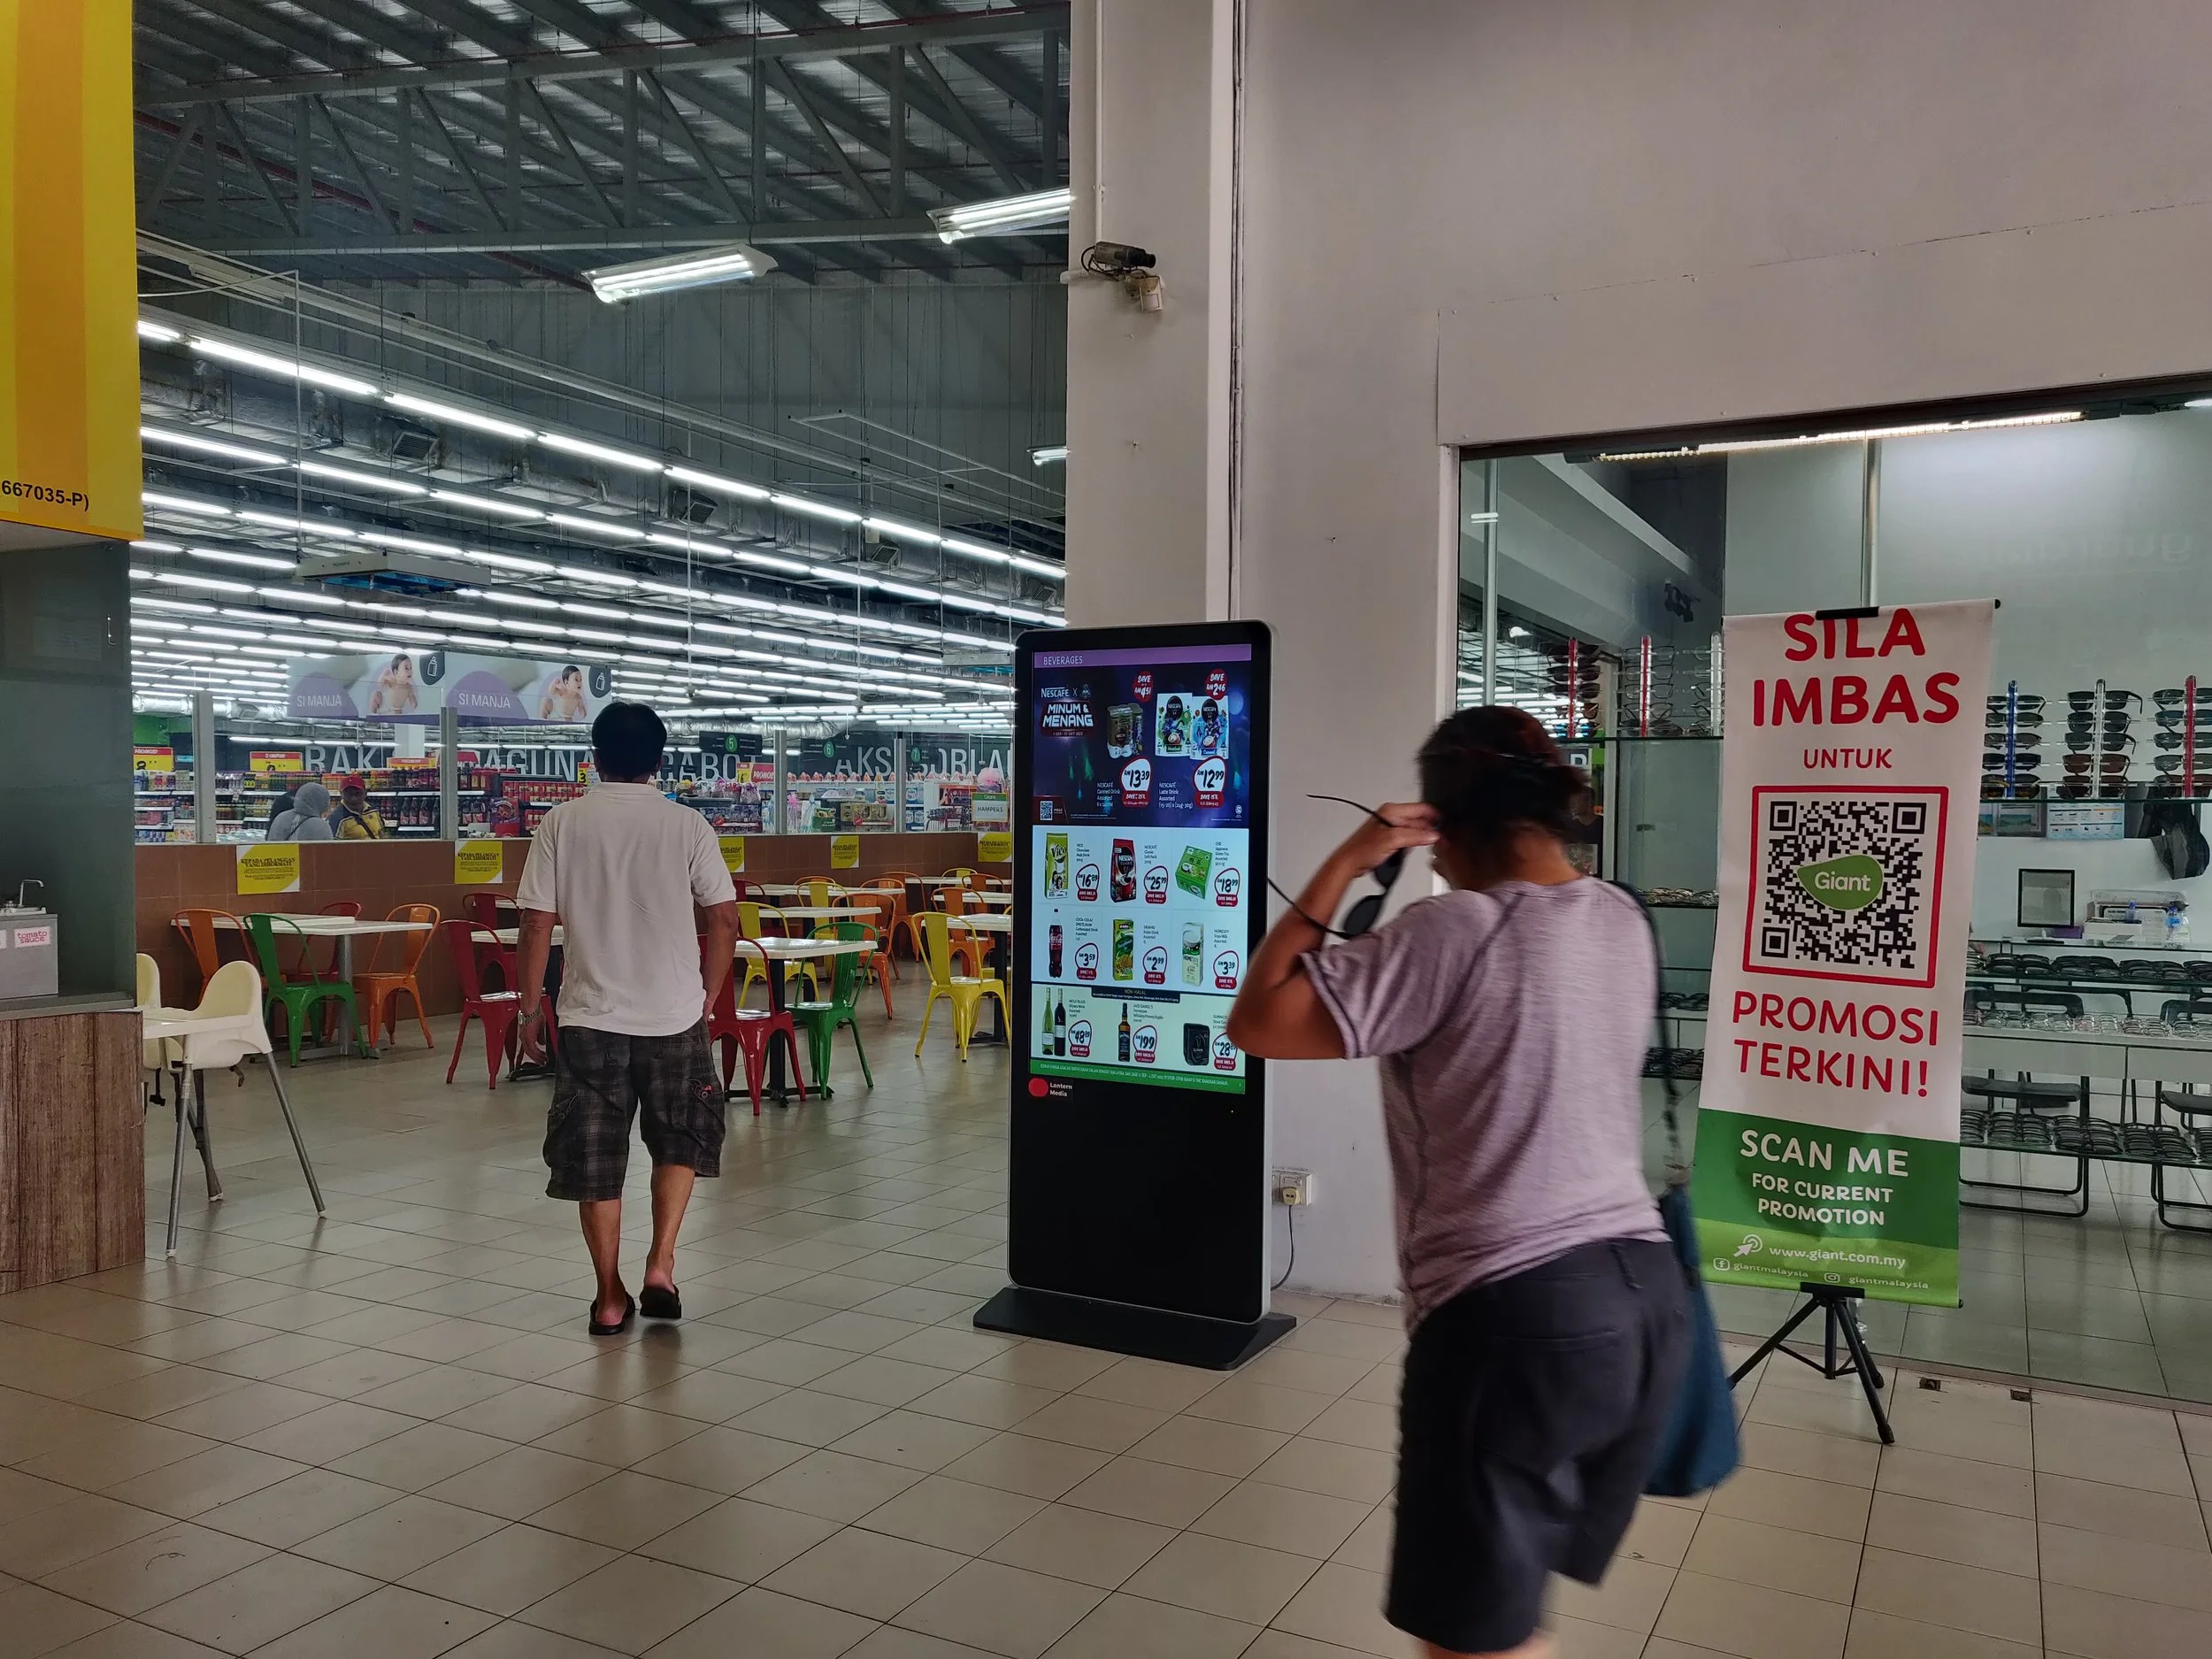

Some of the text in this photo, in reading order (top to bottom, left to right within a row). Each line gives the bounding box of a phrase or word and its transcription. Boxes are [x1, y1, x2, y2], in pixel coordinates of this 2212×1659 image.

[1783, 608, 1926, 662] SILA
[1043, 656, 1083, 665] BEVERAGES
[296, 695, 342, 707] SI MANJA
[458, 693, 511, 709] SI MANJA
[1048, 703, 1090, 714] MINUM &
[1753, 672, 1961, 726] IMBAS
[1042, 714, 1094, 727] MENANG
[728, 737, 733, 749] 5
[826, 744, 831, 755] 6
[1803, 748, 1893, 769] UNTUK
[1814, 871, 1871, 893] Giant
[1732, 990, 1939, 1047] PROMOSI
[1733, 1039, 1929, 1098] TERKINI!
[1740, 1129, 1909, 1177] SCAN ME
[1752, 1173, 1893, 1204] FOR CURRENT
[1758, 1198, 1885, 1225] PROMOTION
[1770, 1247, 1906, 1270] www.giant.com.my
[1733, 1262, 1809, 1279] giantmalaysia
[1848, 1275, 1929, 1289] giantmalaysia
